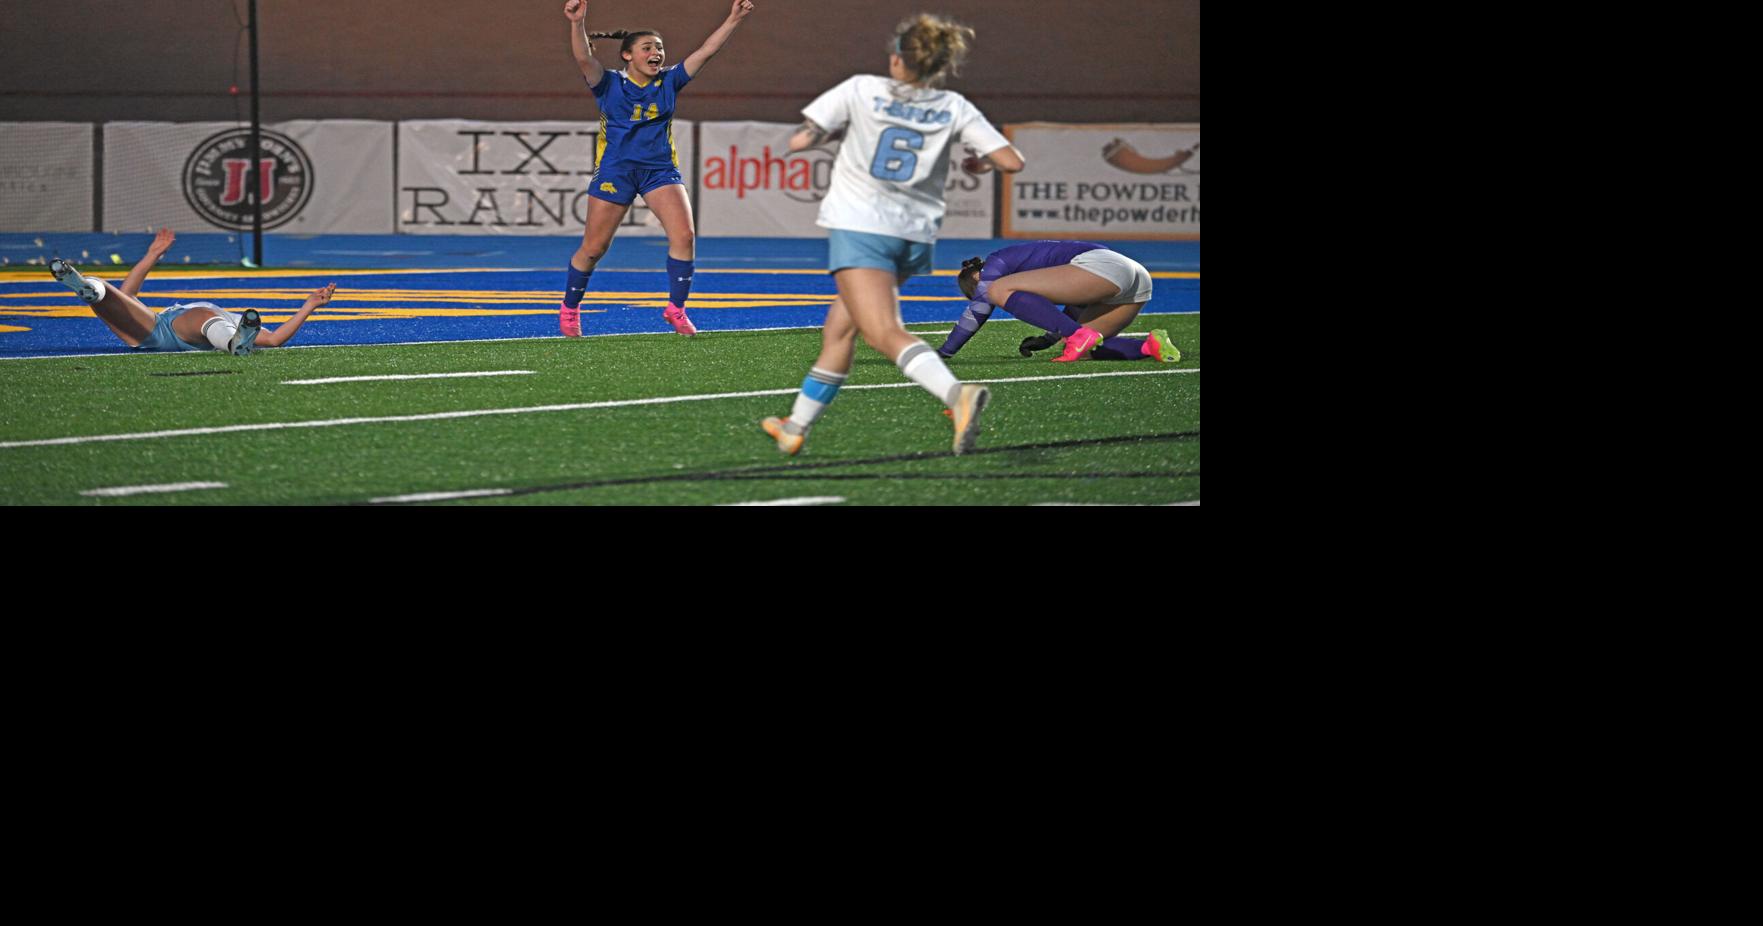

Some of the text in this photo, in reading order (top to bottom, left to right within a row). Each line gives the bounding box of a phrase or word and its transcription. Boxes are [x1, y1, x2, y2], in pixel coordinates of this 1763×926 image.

[630, 103, 659, 121] 14
[869, 126, 924, 182] 6
[1015, 182, 1068, 200] THE
[1077, 182, 1191, 202] POWDER
